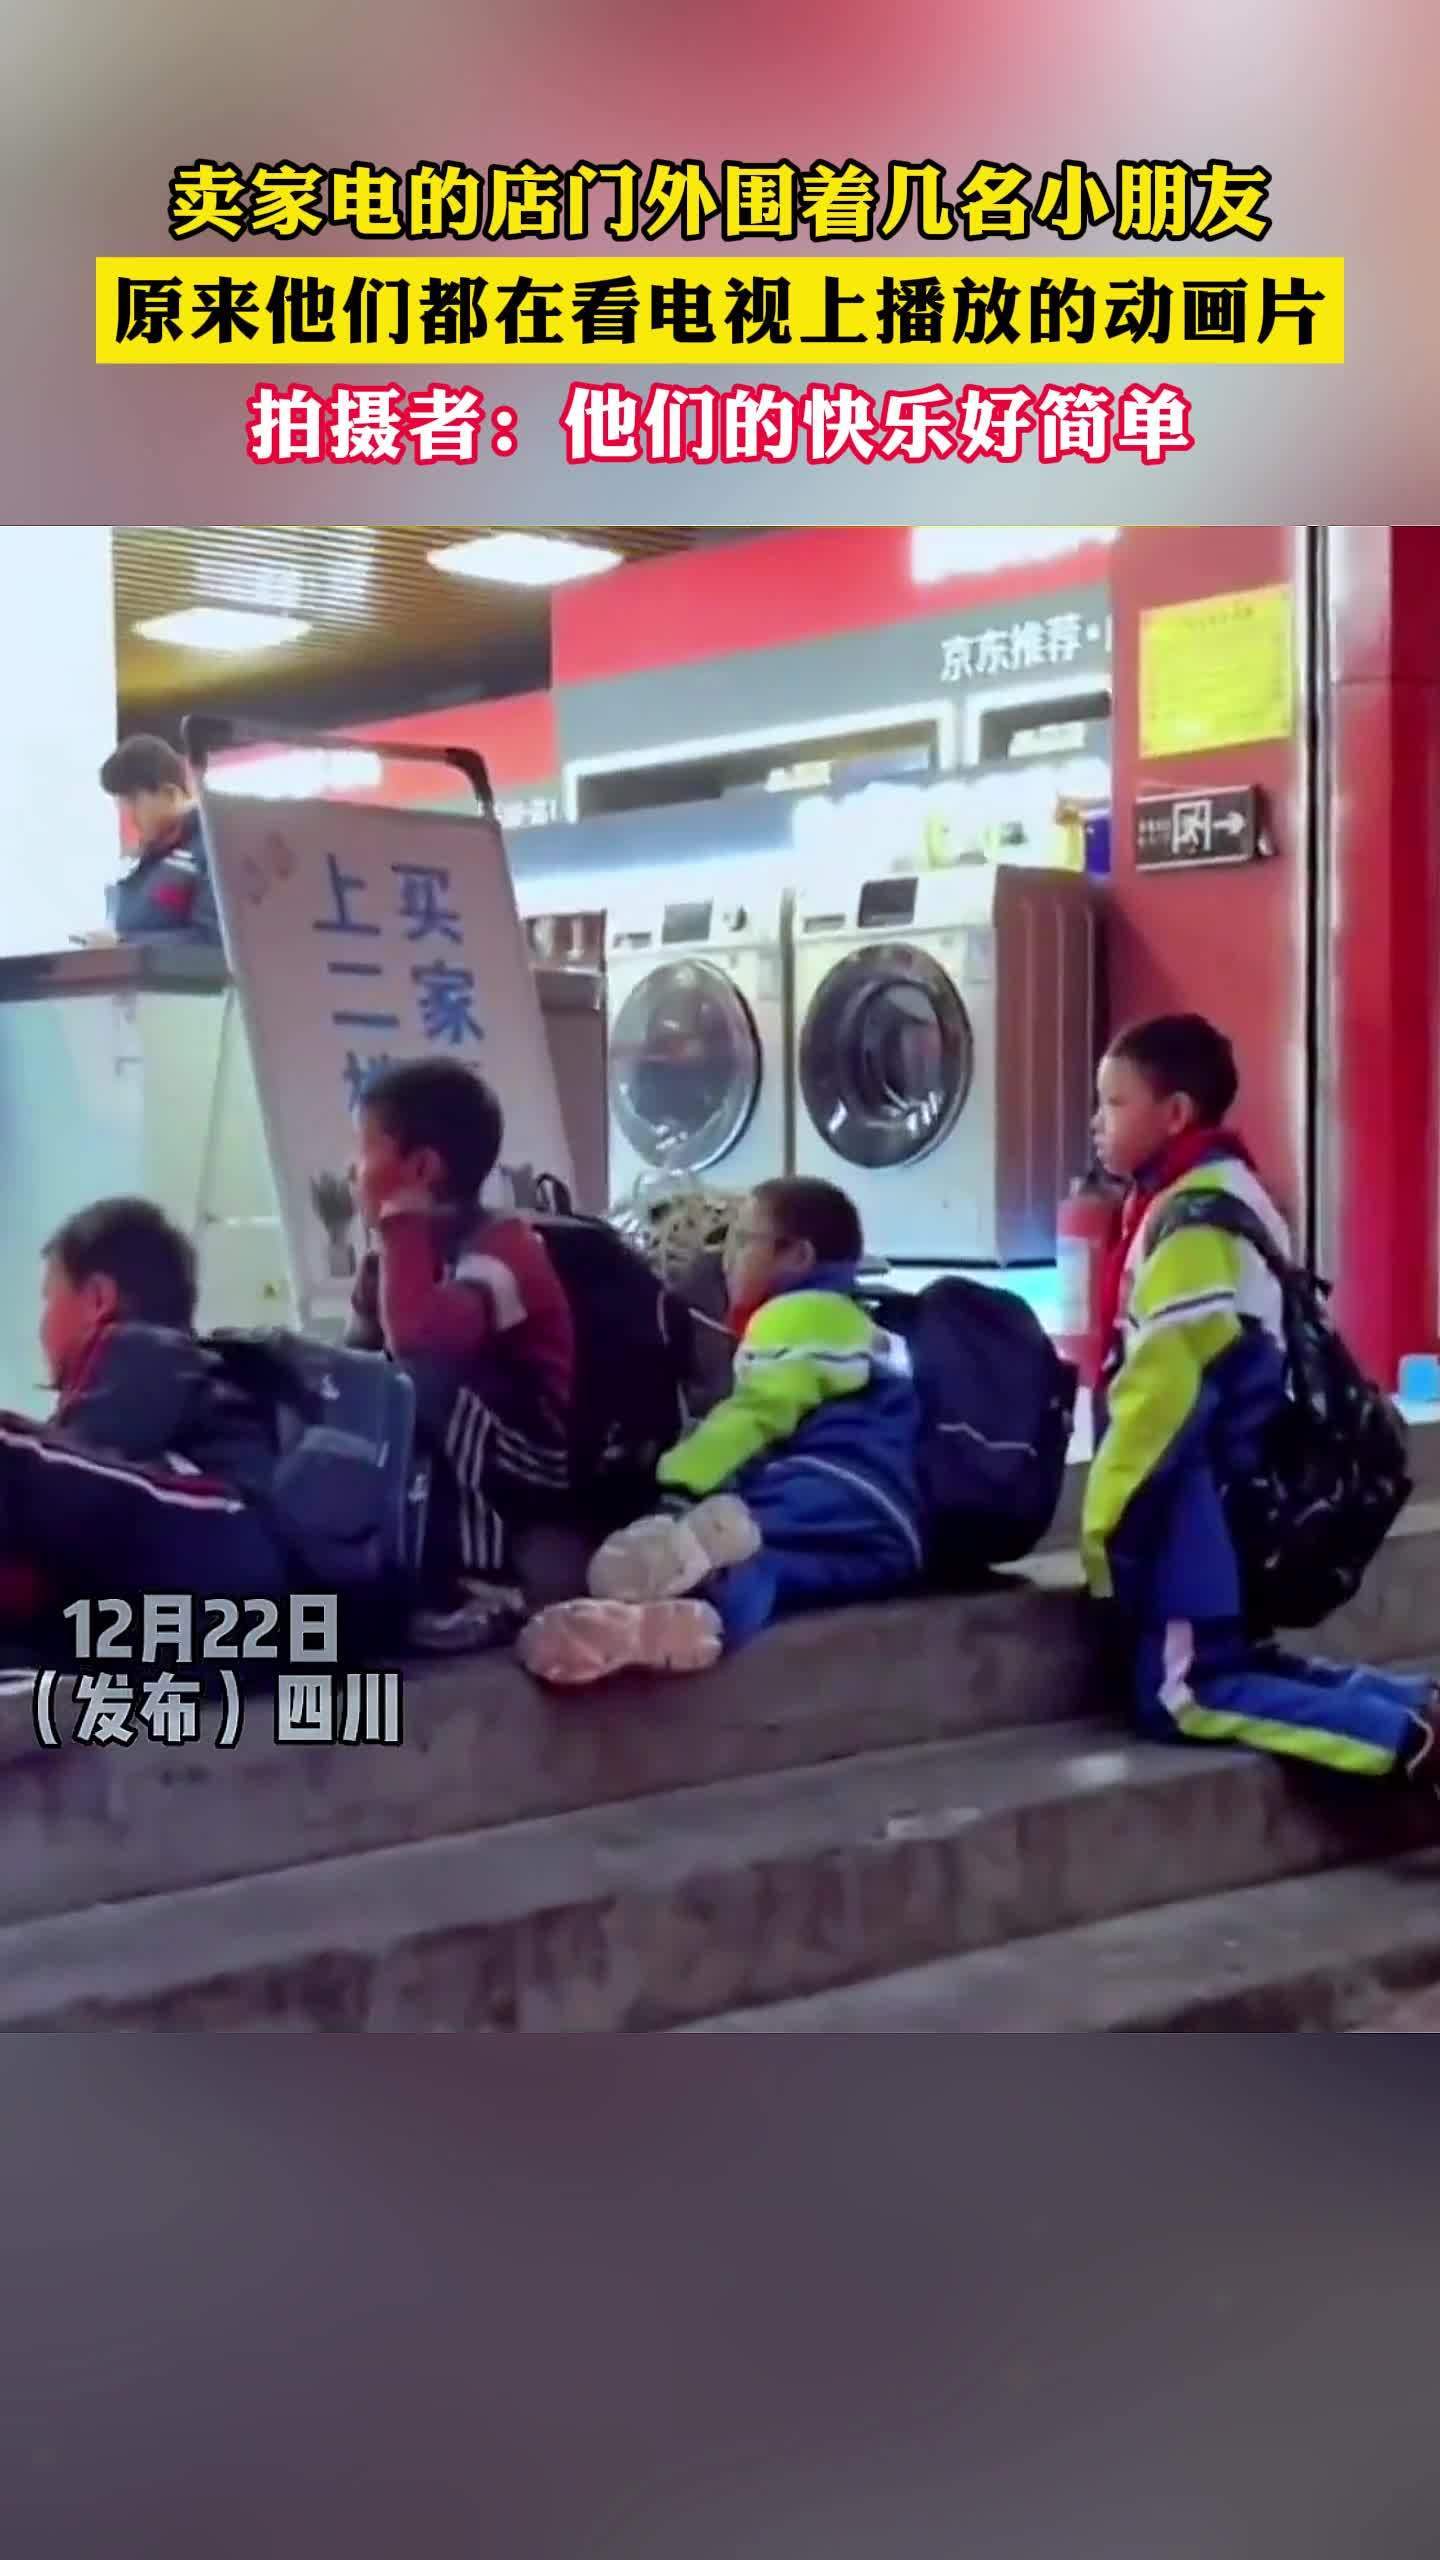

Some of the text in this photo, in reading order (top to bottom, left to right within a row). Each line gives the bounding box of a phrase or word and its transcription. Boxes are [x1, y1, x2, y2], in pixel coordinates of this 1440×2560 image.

[940, 612, 1113, 681] 京东推荐·
[391, 863, 484, 1068] 买家
